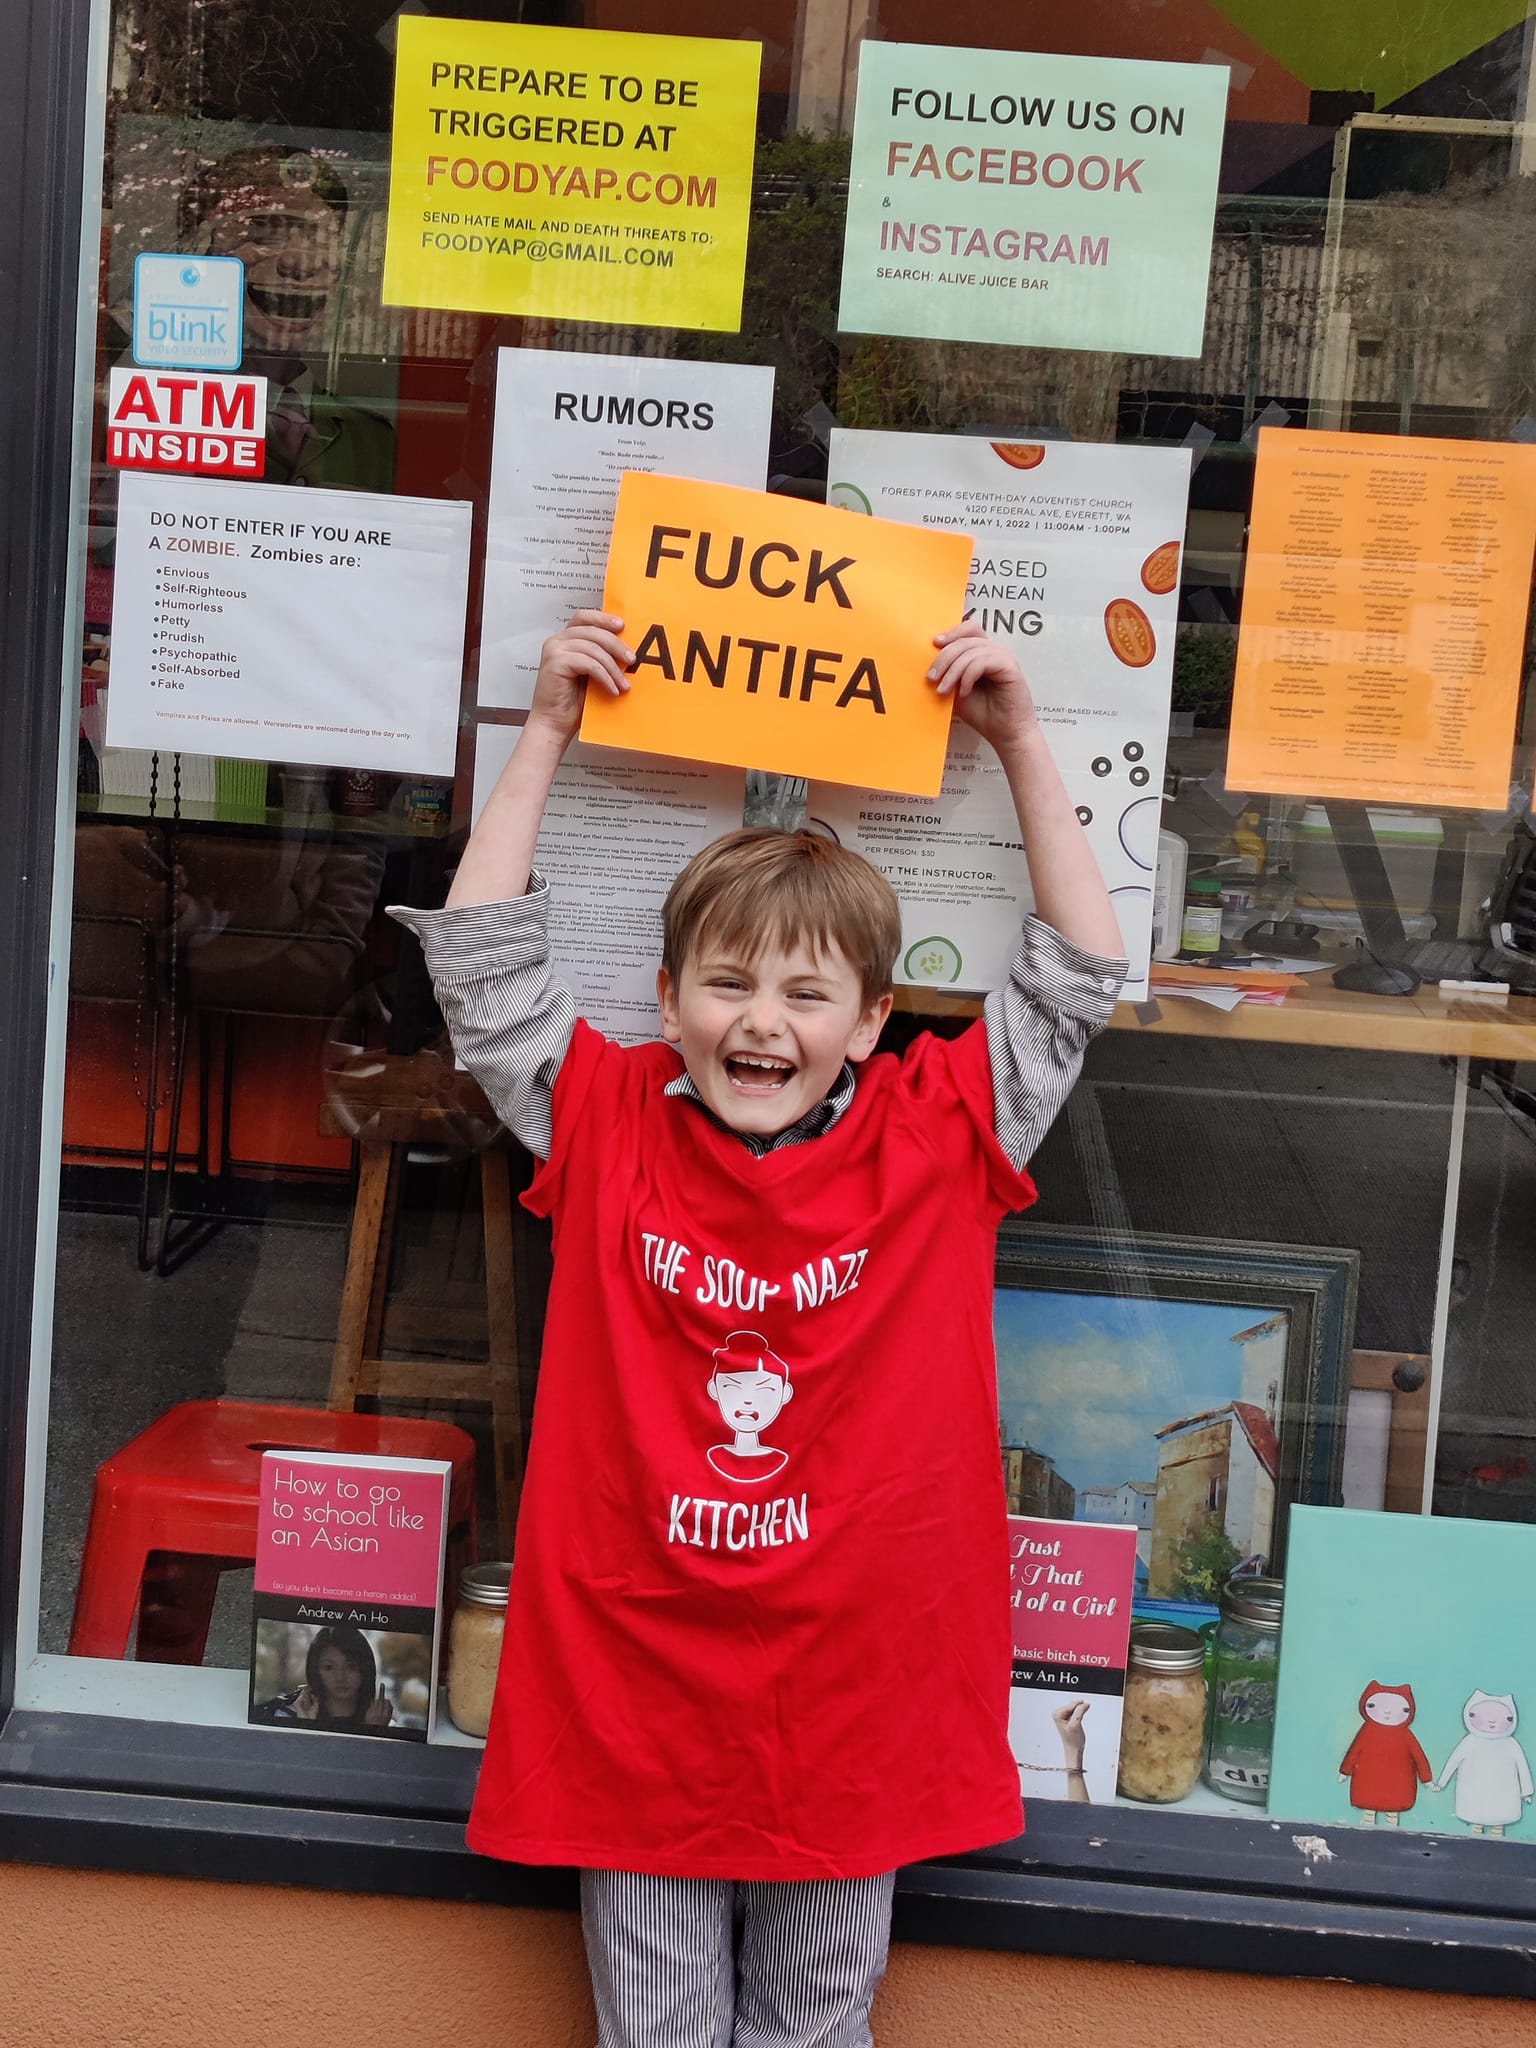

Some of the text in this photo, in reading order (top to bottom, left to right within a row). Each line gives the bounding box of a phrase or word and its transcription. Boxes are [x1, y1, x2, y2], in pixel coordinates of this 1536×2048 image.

[431, 62, 699, 107] PREPARE TO BE
[891, 87, 1184, 136] FOLLOW US ON
[429, 108, 677, 152] TRIGGERED AT
[887, 141, 1145, 194] FACEBOOK
[427, 156, 717, 208] FOODYAP.COM
[882, 197, 891, 208] &
[423, 211, 713, 245] SEND HATE MAIL AND DEATH THREATS TO:
[422, 232, 674, 268] FOODYAP@GMAIL.COM
[880, 221, 1109, 266] INSTAGRAM
[876, 267, 1049, 290] SEARCH: ALIVE JUICE BAR
[149, 311, 226, 343] blink
[114, 375, 256, 431] ATM
[554, 392, 714, 431] RUMORS
[112, 432, 257, 468] INSIDE
[881, 486, 1132, 509] FOREST PARK SEVENTH-DAY ADVENTIST CHURCH
[923, 514, 967, 527] SUNDAY,
[971, 518, 993, 527] MAY
[1006, 520, 1030, 529] 2022
[1044, 522, 1084, 532] 11:00AM
[1094, 524, 1130, 534] 1:00PM
[965, 505, 1131, 522] 4120 FEDERAL AVE, EVERETT, WA
[151, 512, 392, 546] DO NOT ENTER IF YOU ARE
[149, 537, 361, 568] A ZOMBIE. Zombies are:
[163, 566, 210, 580] Envious
[645, 524, 856, 609] FUCK
[162, 582, 247, 599] Self-Righteous
[162, 599, 223, 613] Humorless
[161, 615, 190, 628] Petty
[160, 631, 205, 643] Prudish
[159, 647, 237, 664] Psychopathic
[158, 663, 241, 679] Self-Absorbed
[624, 624, 886, 715] ANTIFA
[158, 679, 185, 691] Fake
[1043, 706, 1092, 715] PLANT-BASED
[156, 711, 186, 720] Vampires
[315, 724, 348, 734] welcomed
[349, 727, 370, 737] during
[383, 730, 395, 738] day
[860, 812, 941, 824] REGISTRATION
[878, 826, 903, 834] through
[858, 832, 893, 841] Registration
[898, 866, 918, 876] THE
[922, 868, 996, 880] INSTRUCTOR:
[642, 1233, 691, 1294] THE
[792, 1248, 868, 1312] NAZI
[274, 1468, 400, 1506] How to go
[273, 1498, 424, 1530] to school like
[668, 1493, 809, 1550] KITCHEN
[271, 1526, 380, 1553] an Asian
[1010, 1534, 1061, 1558] Just
[1020, 1563, 1084, 1586] That
[285, 1583, 300, 1593] you
[322, 1586, 354, 1596] become
[297, 1604, 388, 1624] Andrew An Ho
[1026, 1590, 1046, 1612] of
[1052, 1599, 1066, 1613] a
[1072, 1595, 1117, 1619] Girl
[1013, 1646, 1110, 1667] basic bitch story
[1010, 1668, 1079, 1684] rew An Ho
